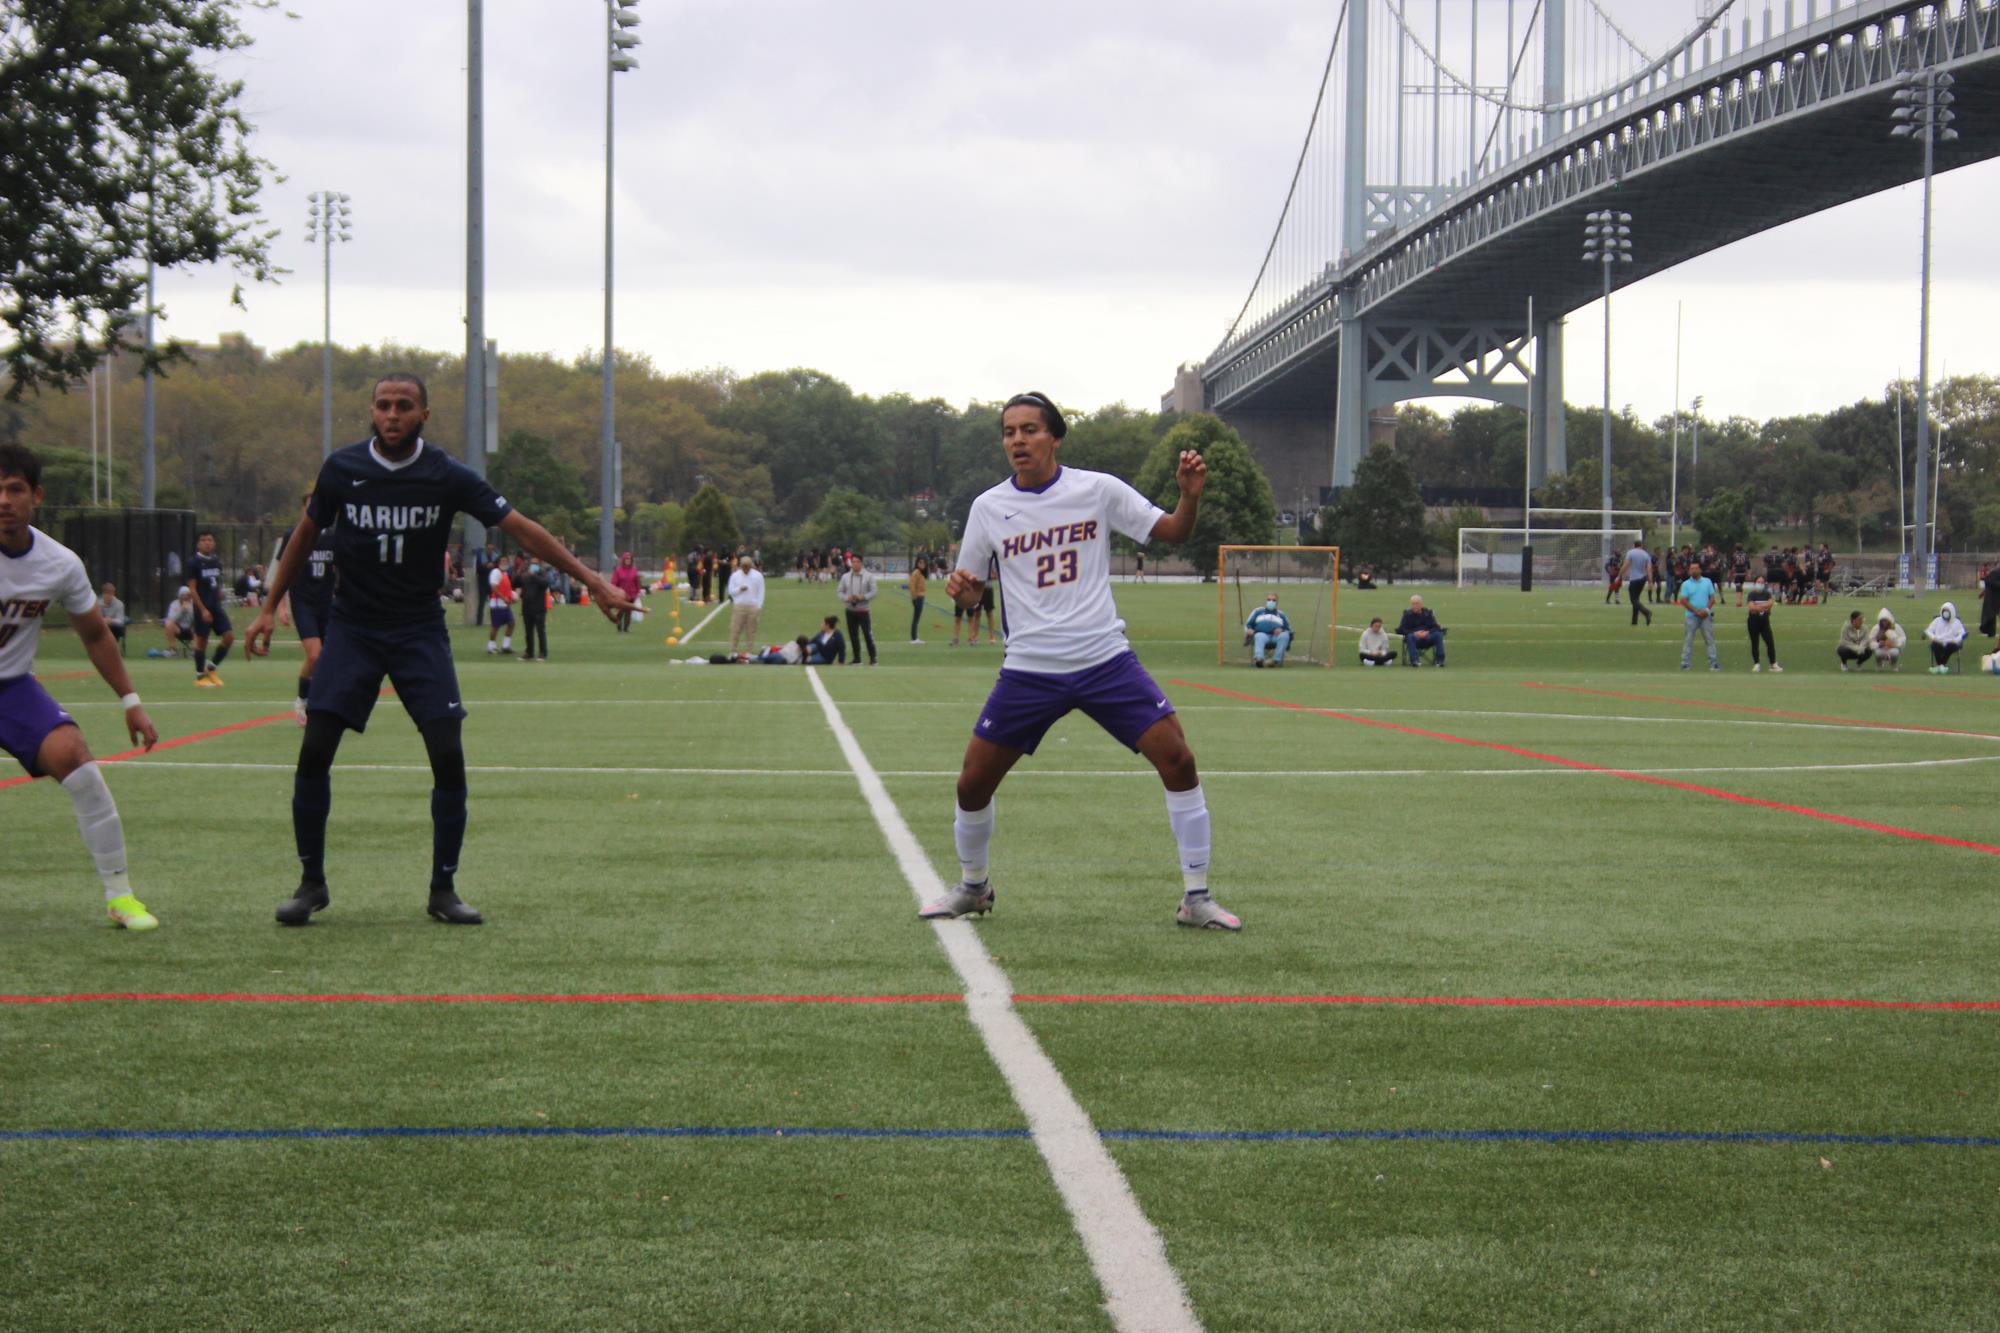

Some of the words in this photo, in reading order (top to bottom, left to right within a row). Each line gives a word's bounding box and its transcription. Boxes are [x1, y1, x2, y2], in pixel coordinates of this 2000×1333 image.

[377, 533, 405, 564] 11
[1002, 519, 1098, 560] HUNTER
[312, 561, 326, 577] 10
[1036, 548, 1078, 590] 23
